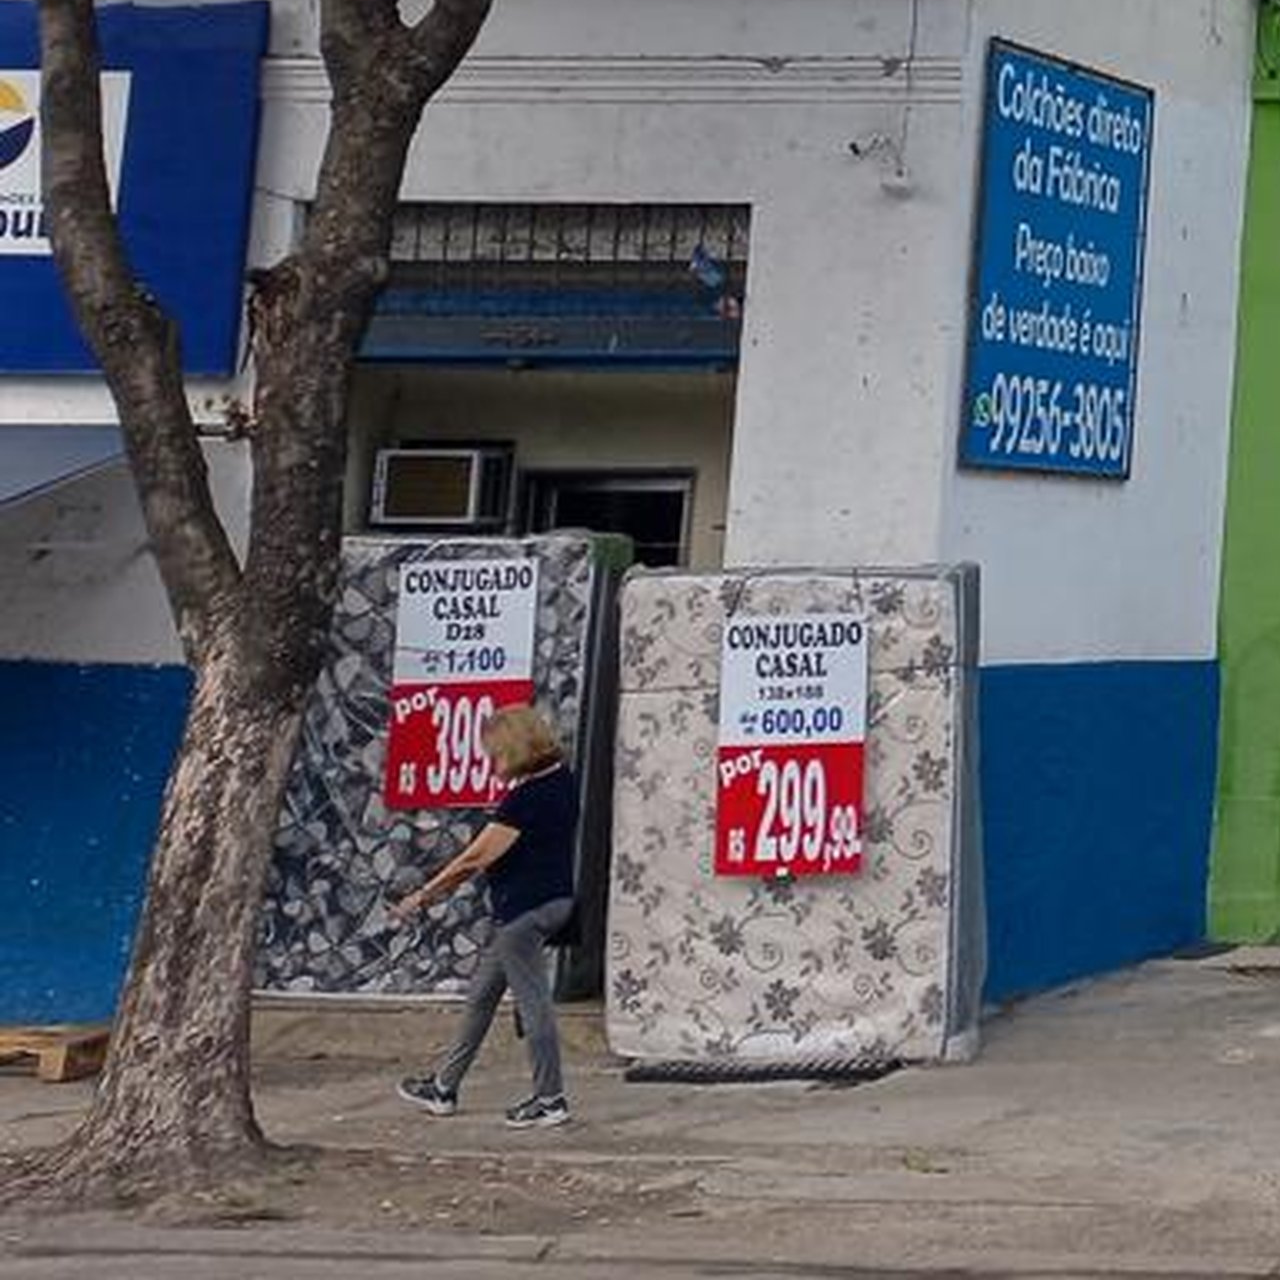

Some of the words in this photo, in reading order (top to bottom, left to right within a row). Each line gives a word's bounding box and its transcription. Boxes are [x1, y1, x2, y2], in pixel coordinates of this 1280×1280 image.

[998, 62, 1084, 138] Colchões
[1087, 93, 1141, 154] direto
[1013, 137, 1043, 195] da
[1046, 145, 1121, 214] Fábrica
[1015, 222, 1064, 288] Preço
[1066, 232, 1110, 287] baixo
[982, 292, 1006, 341] de
[1009, 300, 1077, 353] verdade
[1079, 308, 1091, 355] é
[1092, 318, 1130, 366] aqui
[990, 372, 1125, 461] 99256-3805
[405, 566, 533, 594] CONJUGADO
[433, 595, 500, 621] CASAL
[727, 622, 863, 650] CONJUGADO
[755, 652, 828, 678] CASAL
[394, 687, 439, 724] por
[761, 705, 843, 738] 600,00
[718, 748, 764, 788] por
